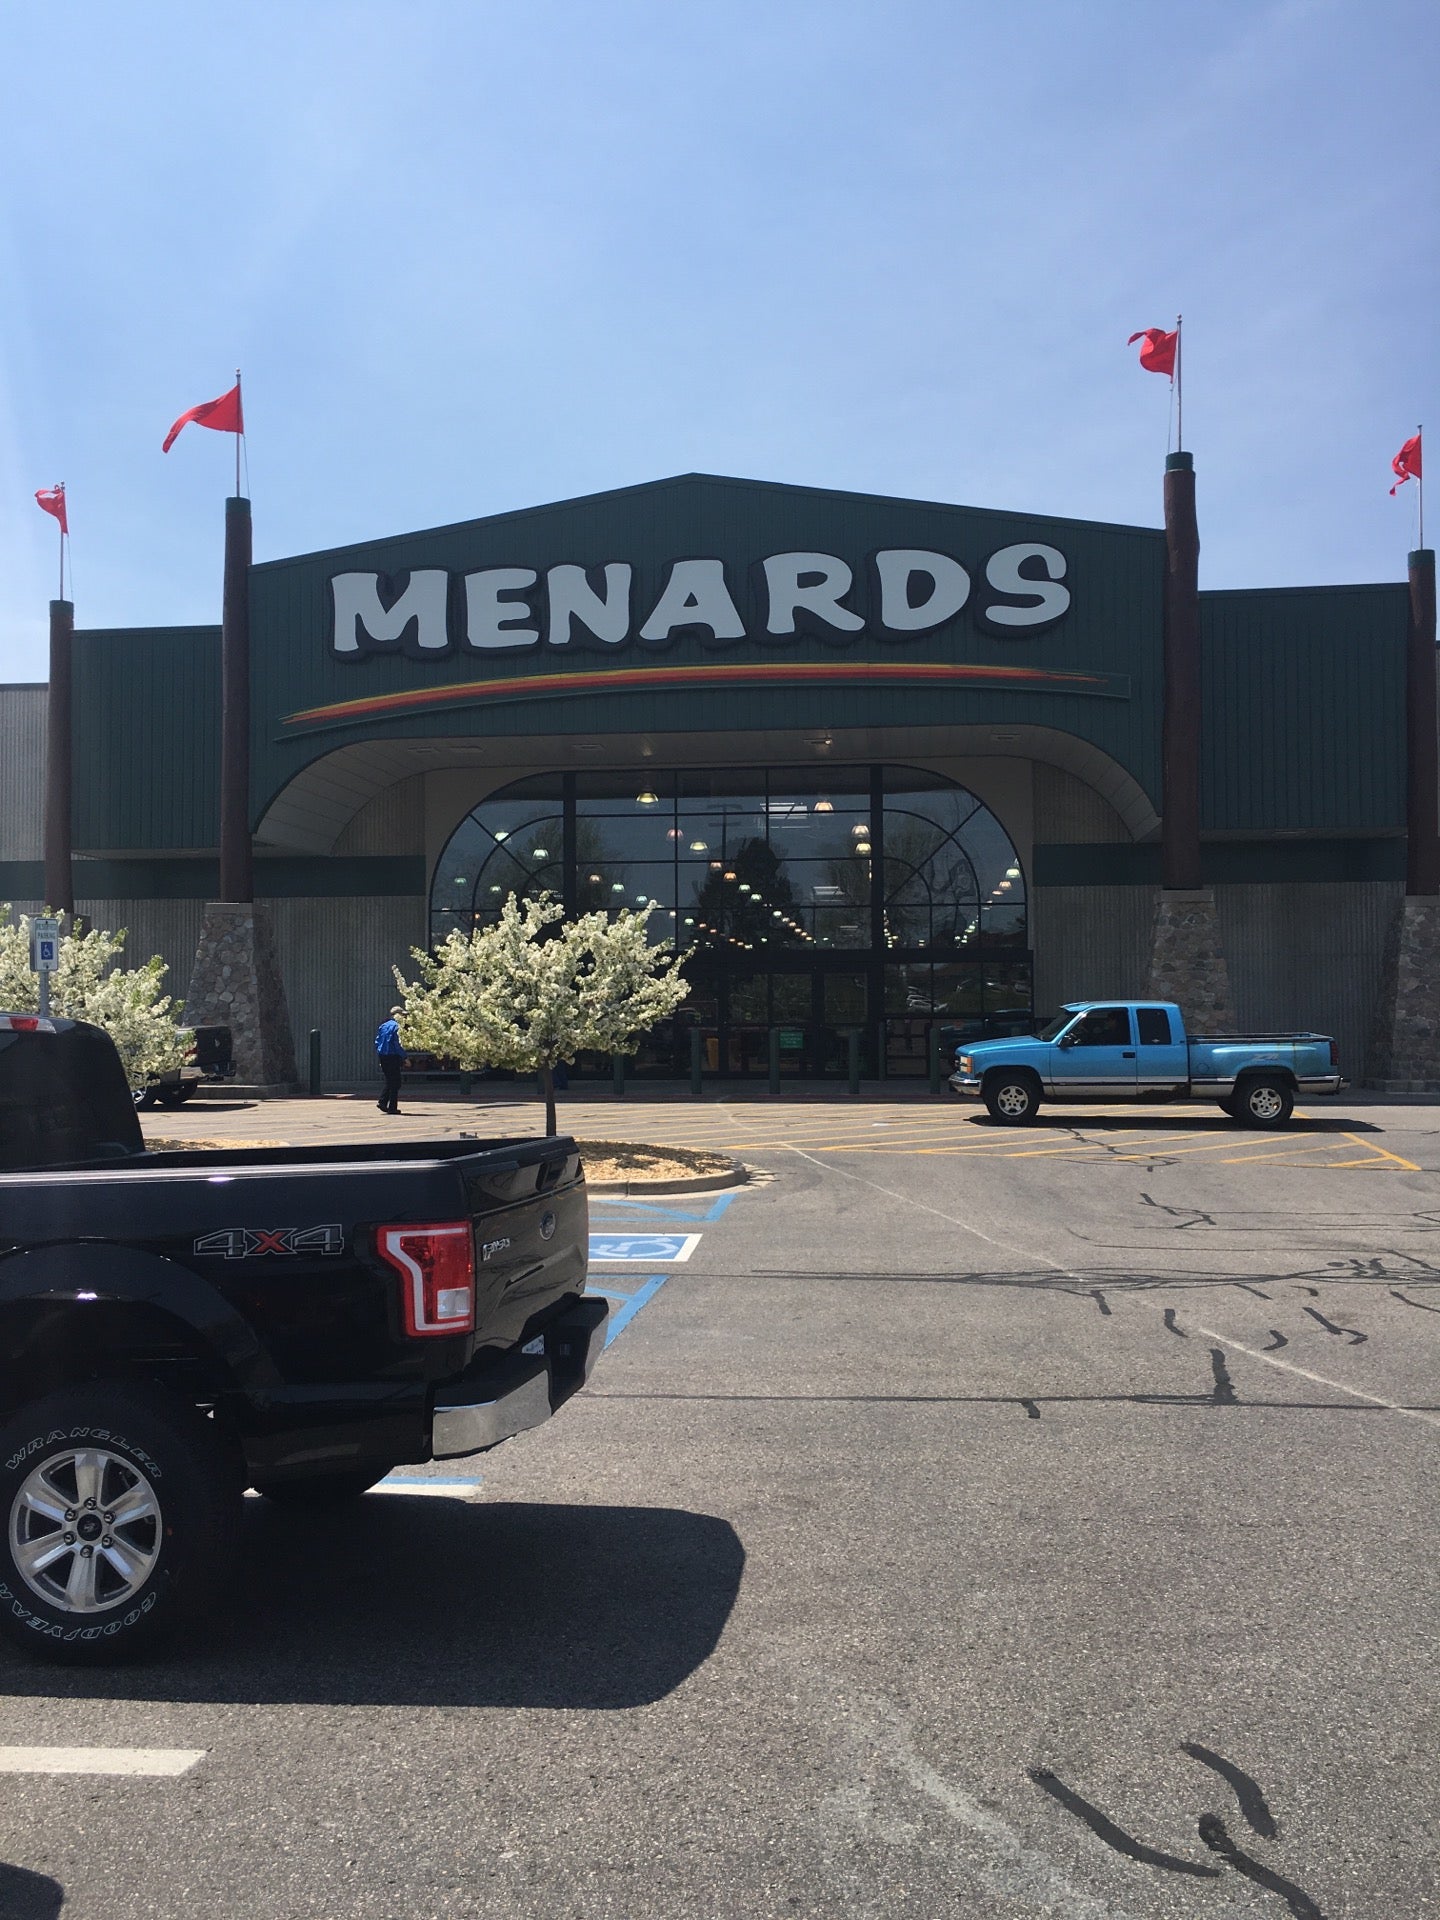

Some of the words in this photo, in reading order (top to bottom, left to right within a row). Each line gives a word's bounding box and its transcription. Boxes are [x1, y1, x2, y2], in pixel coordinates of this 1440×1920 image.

[331, 543, 1071, 652] MENARDS
[6, 1427, 162, 1478] WRANGLER
[0, 1582, 156, 1641] GOODYEAR
